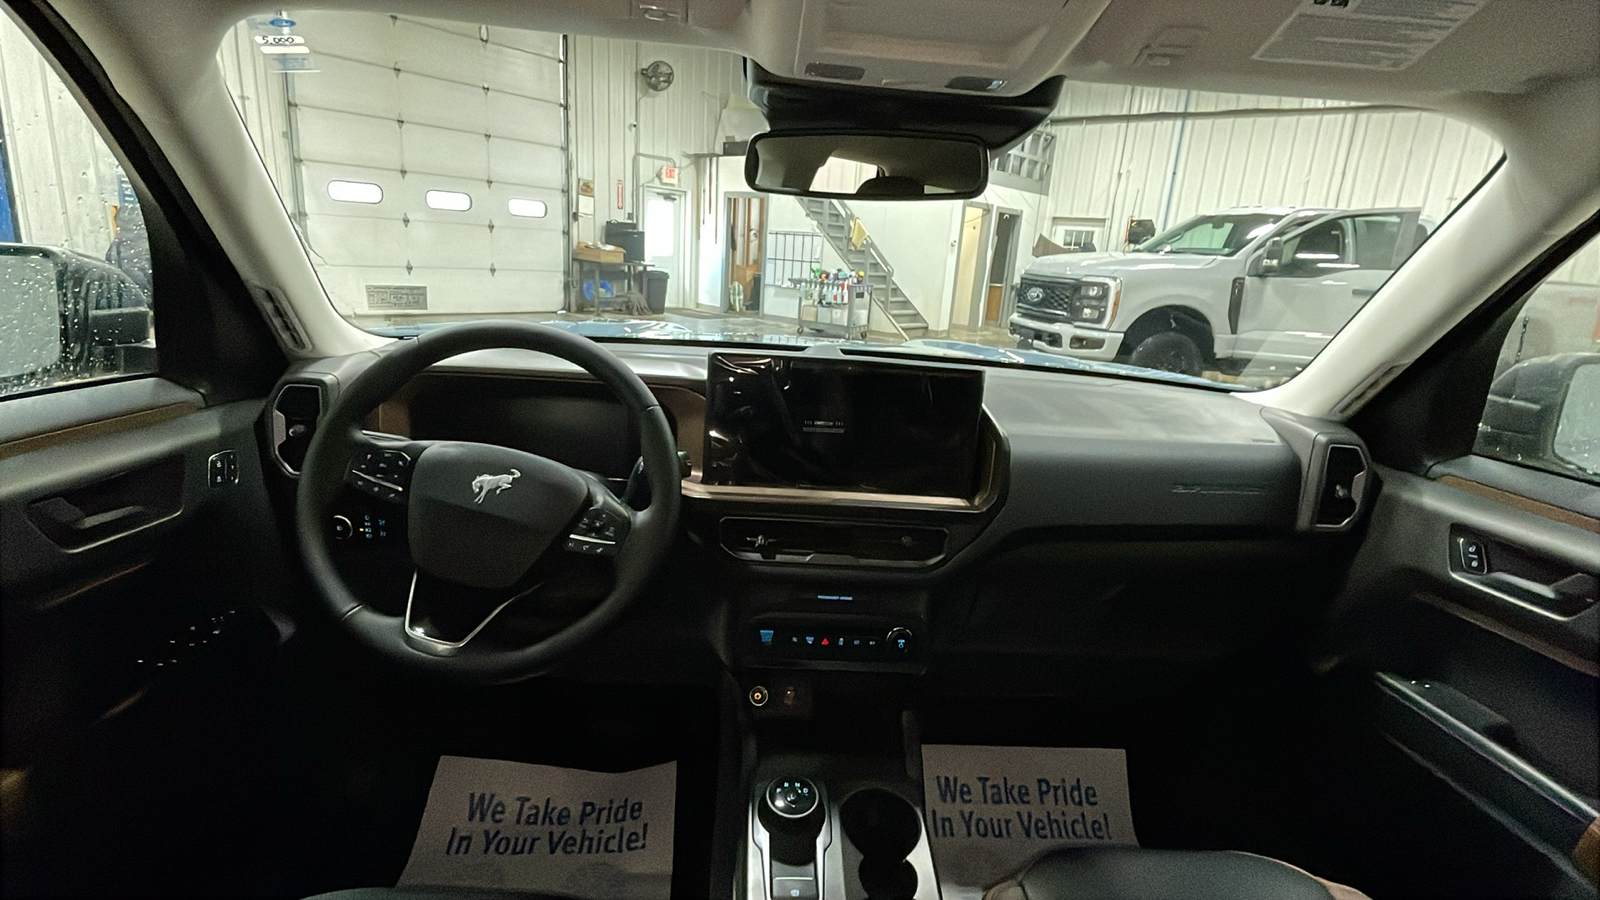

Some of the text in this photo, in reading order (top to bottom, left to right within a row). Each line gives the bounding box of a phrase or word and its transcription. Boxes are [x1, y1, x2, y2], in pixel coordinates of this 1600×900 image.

[936, 776, 1098, 806] We Take Pride
[467, 792, 643, 826] We Take Pride
[931, 808, 1112, 840] In Your Vehicle!
[446, 823, 648, 856] In Your Vehicle!
